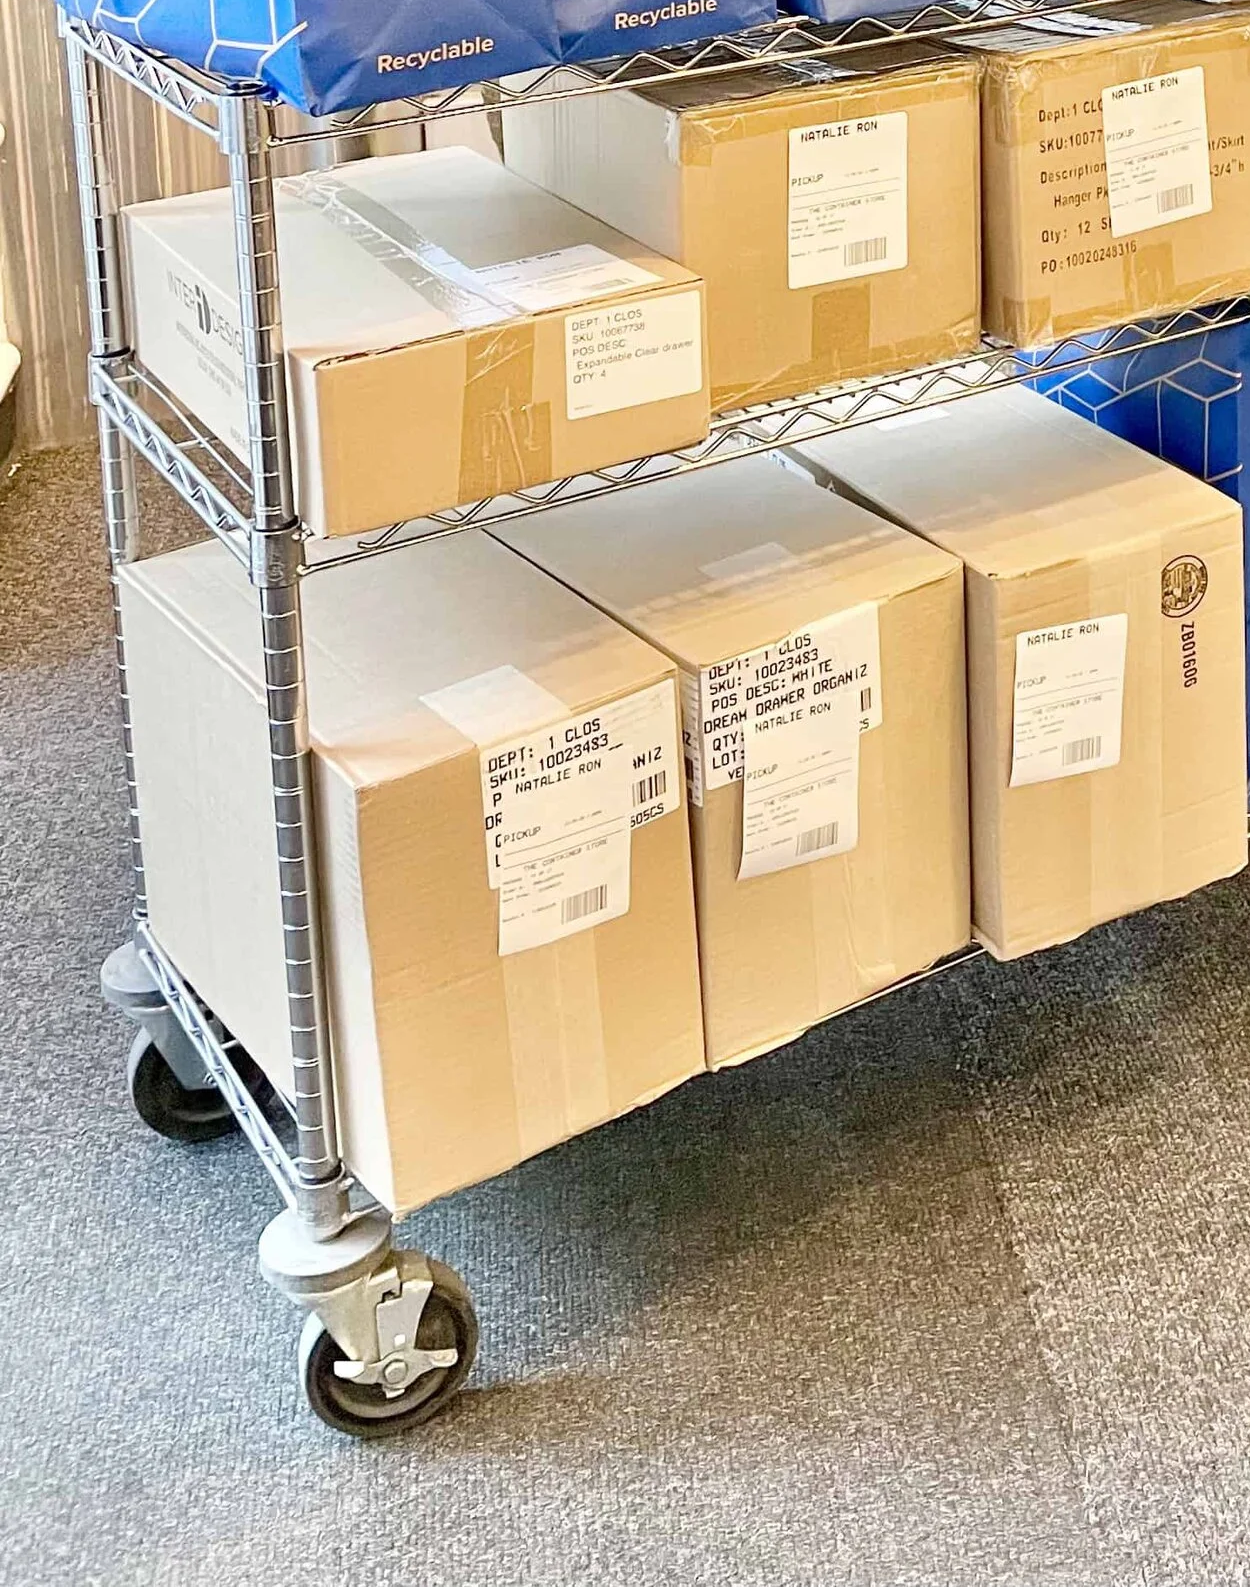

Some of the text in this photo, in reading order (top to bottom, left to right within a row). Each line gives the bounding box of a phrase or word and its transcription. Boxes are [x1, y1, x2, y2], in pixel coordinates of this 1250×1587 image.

[377, 36, 495, 74] Recyclable
[1112, 77, 1178, 101] NATALIE RON
[801, 121, 878, 143] NATALIE RON
[1040, 129, 1104, 153] SKU:10077
[1106, 129, 1135, 143] PICKUP
[1208, 134, 1245, 150] t/Skirt
[791, 174, 824, 187] PICKUP
[1054, 191, 1091, 208] Hanger
[1042, 228, 1068, 244] Qty:
[1078, 221, 1091, 234] 12
[614, 309, 643, 322] CLOS
[572, 345, 595, 357] POS
[577, 339, 694, 371] Expandable Clear drawer
[1027, 623, 1100, 647] NATALIE RON
[709, 657, 750, 681] DEPT:
[779, 633, 812, 656] CLOS
[1181, 621, 1198, 688] ZB01606
[709, 648, 819, 696] SKU: 10023483
[813, 664, 868, 695] ORGANIZ
[1017, 676, 1047, 689] PICKUP
[712, 693, 738, 713] POS
[746, 678, 786, 701] DESC:
[755, 702, 831, 733] NATALIE RON
[488, 746, 533, 774] DEPT:
[565, 718, 601, 743] CLOS
[538, 733, 609, 771] 10023483
[712, 731, 744, 752] QTY:
[638, 747, 662, 767] NIZ
[712, 749, 744, 770] LOT:
[515, 759, 602, 794] NATALIE RON
[746, 764, 779, 782] PICKUP
[503, 826, 541, 844] PICKUP
